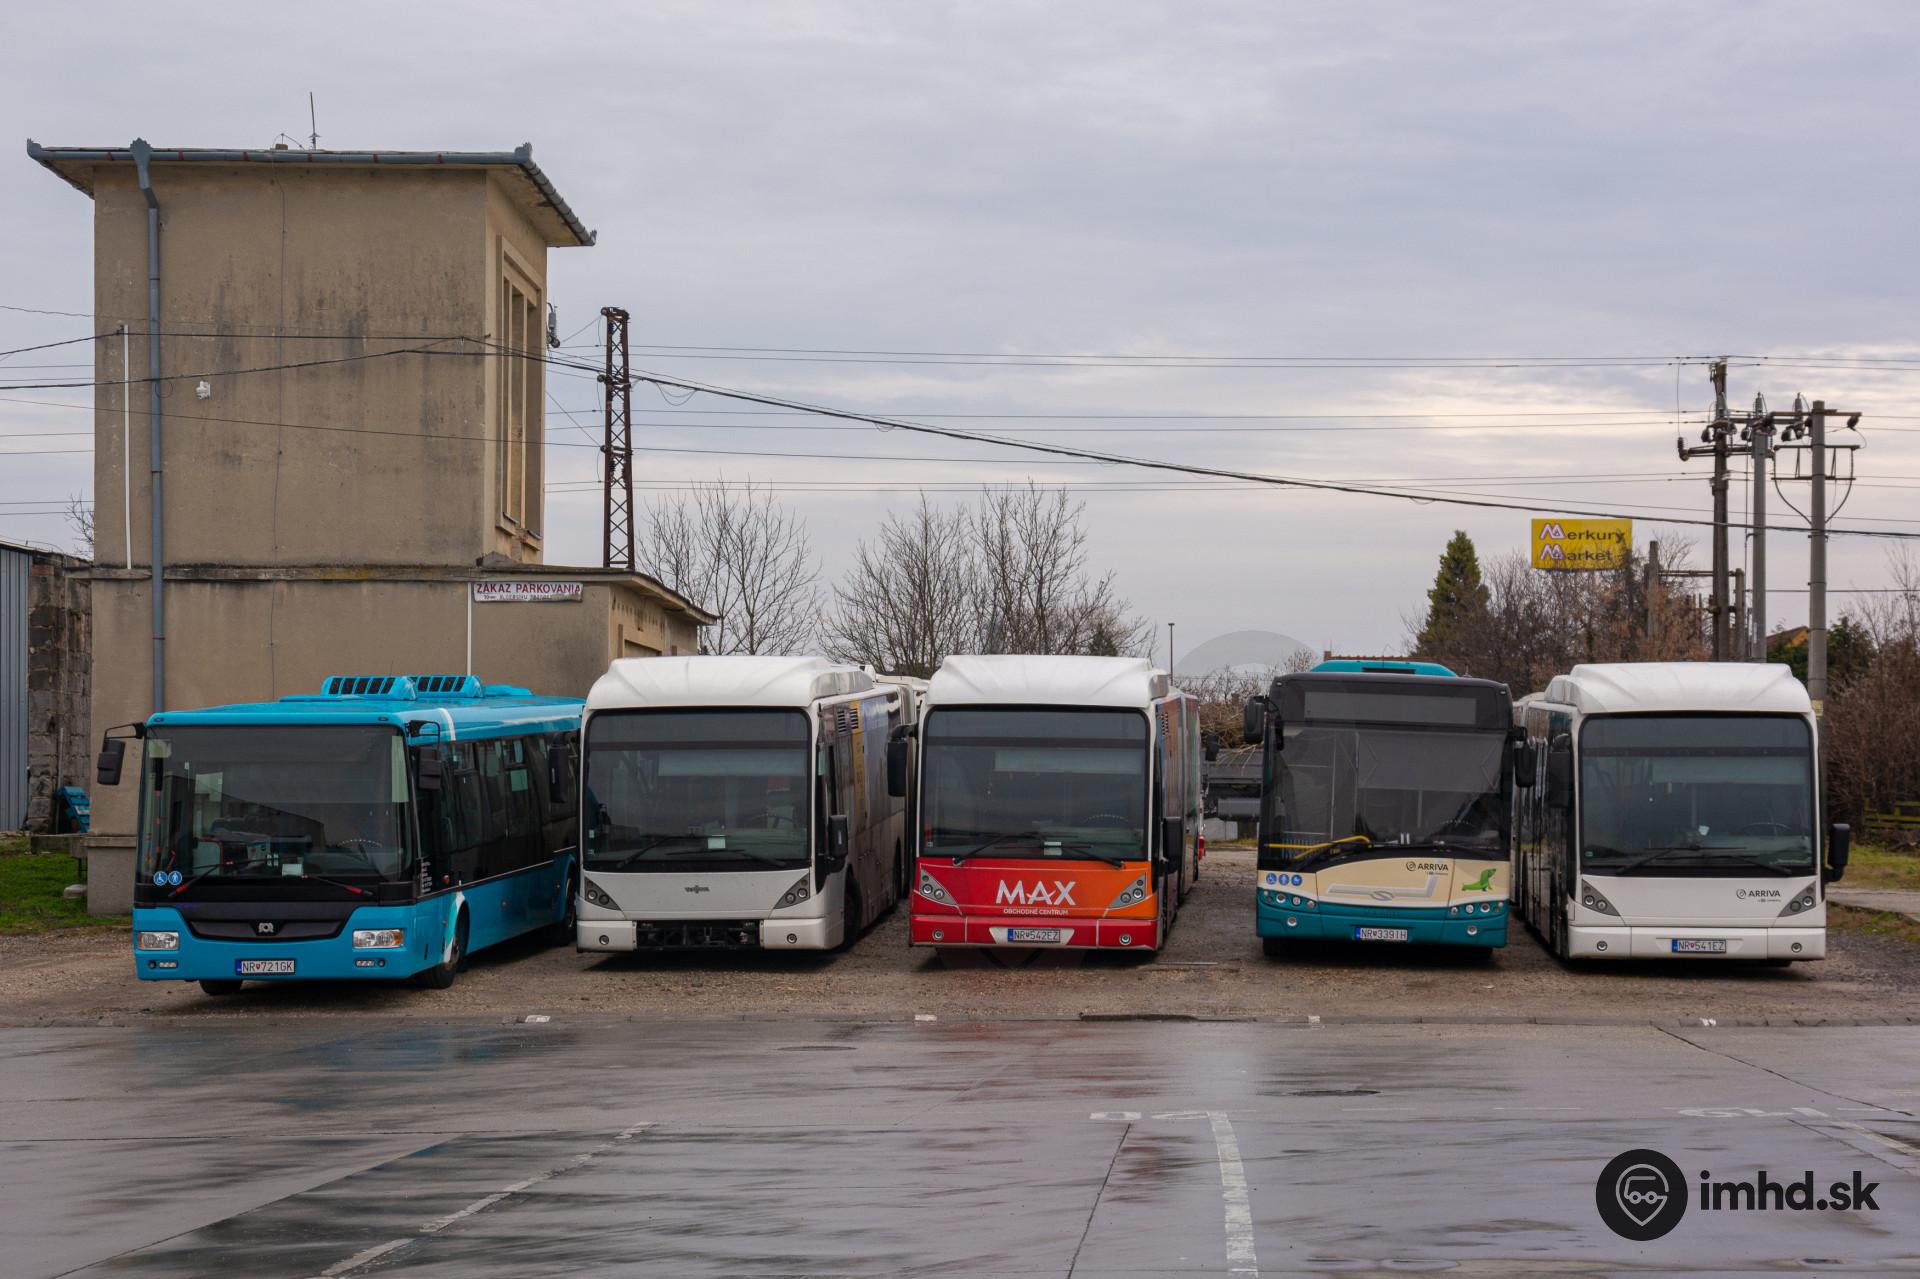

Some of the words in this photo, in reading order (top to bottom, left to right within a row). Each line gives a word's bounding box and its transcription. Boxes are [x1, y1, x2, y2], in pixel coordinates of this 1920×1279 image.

[1540, 523, 1625, 543] Merkury
[1540, 543, 1613, 560] Market
[516, 583, 581, 593] PARKOVANIA
[1417, 863, 1449, 871] ARRIVA
[995, 879, 1076, 906] MAX
